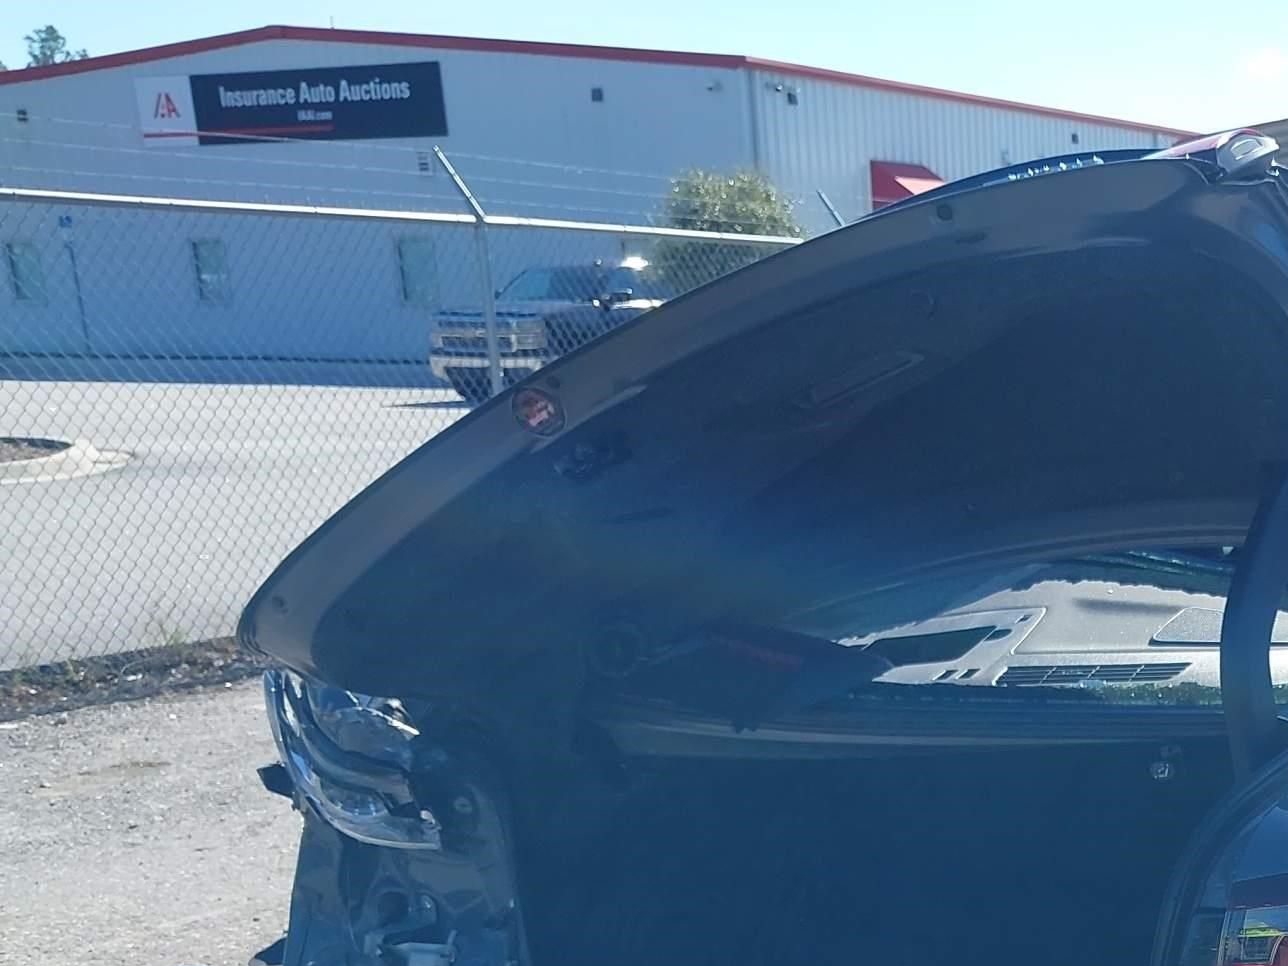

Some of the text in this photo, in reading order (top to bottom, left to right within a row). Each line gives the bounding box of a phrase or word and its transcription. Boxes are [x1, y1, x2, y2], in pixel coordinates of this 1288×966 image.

[218, 77, 411, 108] Insurance Auto Auctions
